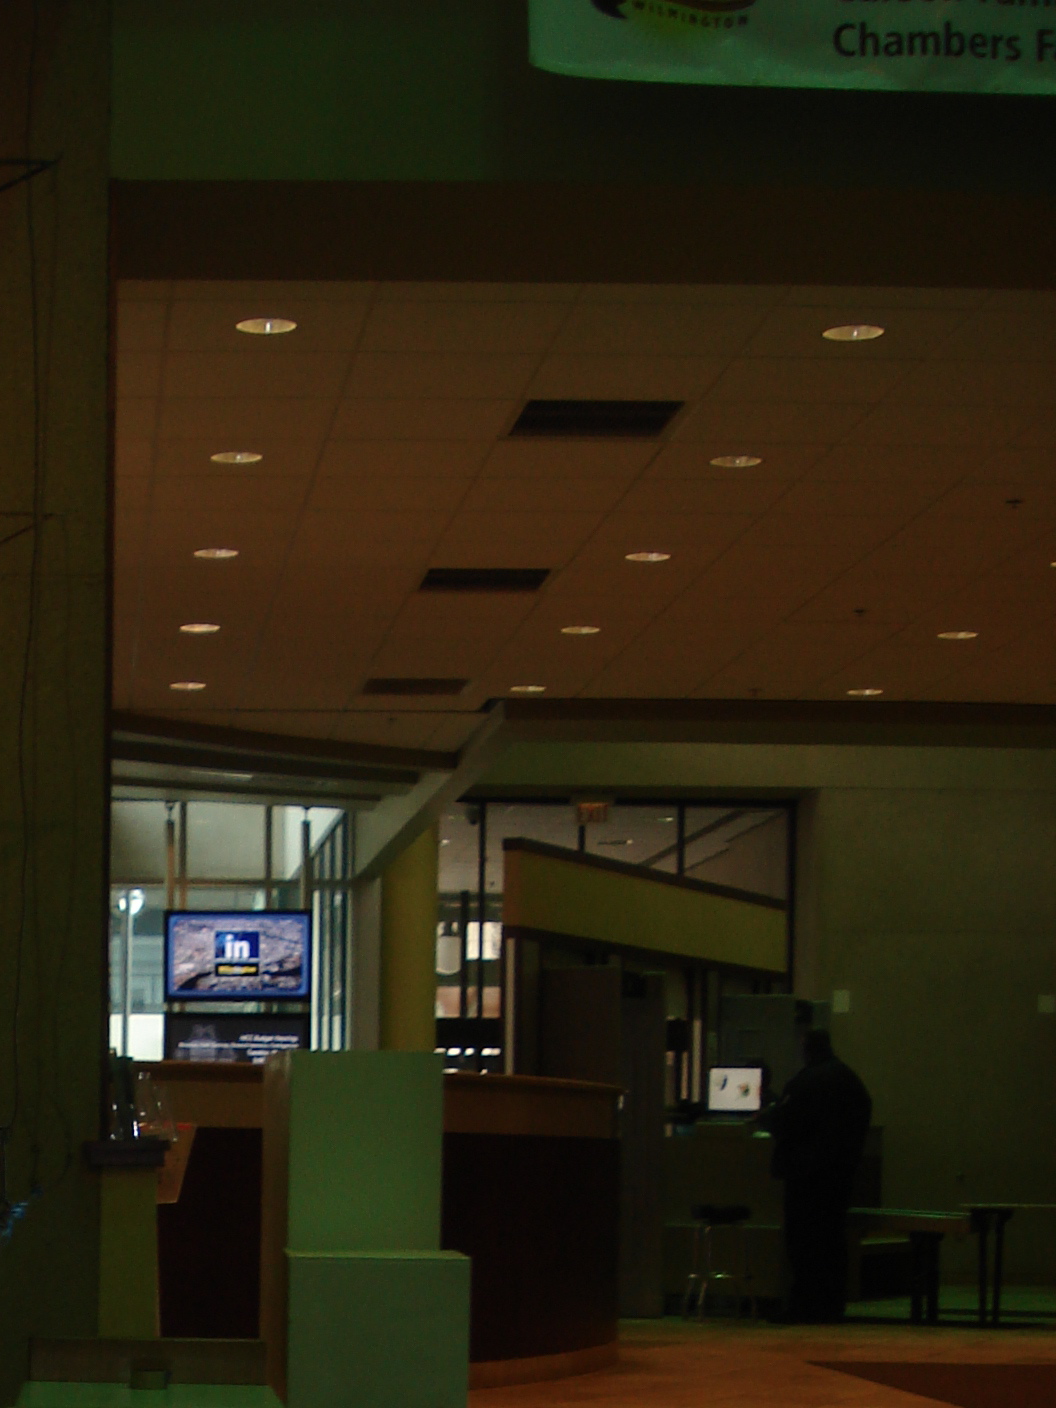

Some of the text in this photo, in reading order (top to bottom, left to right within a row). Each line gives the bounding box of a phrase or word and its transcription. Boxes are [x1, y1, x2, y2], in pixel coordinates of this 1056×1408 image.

[631, 0, 749, 28] WILMINGTON
[832, 21, 1021, 62] Chambers
[225, 934, 251, 959] in
